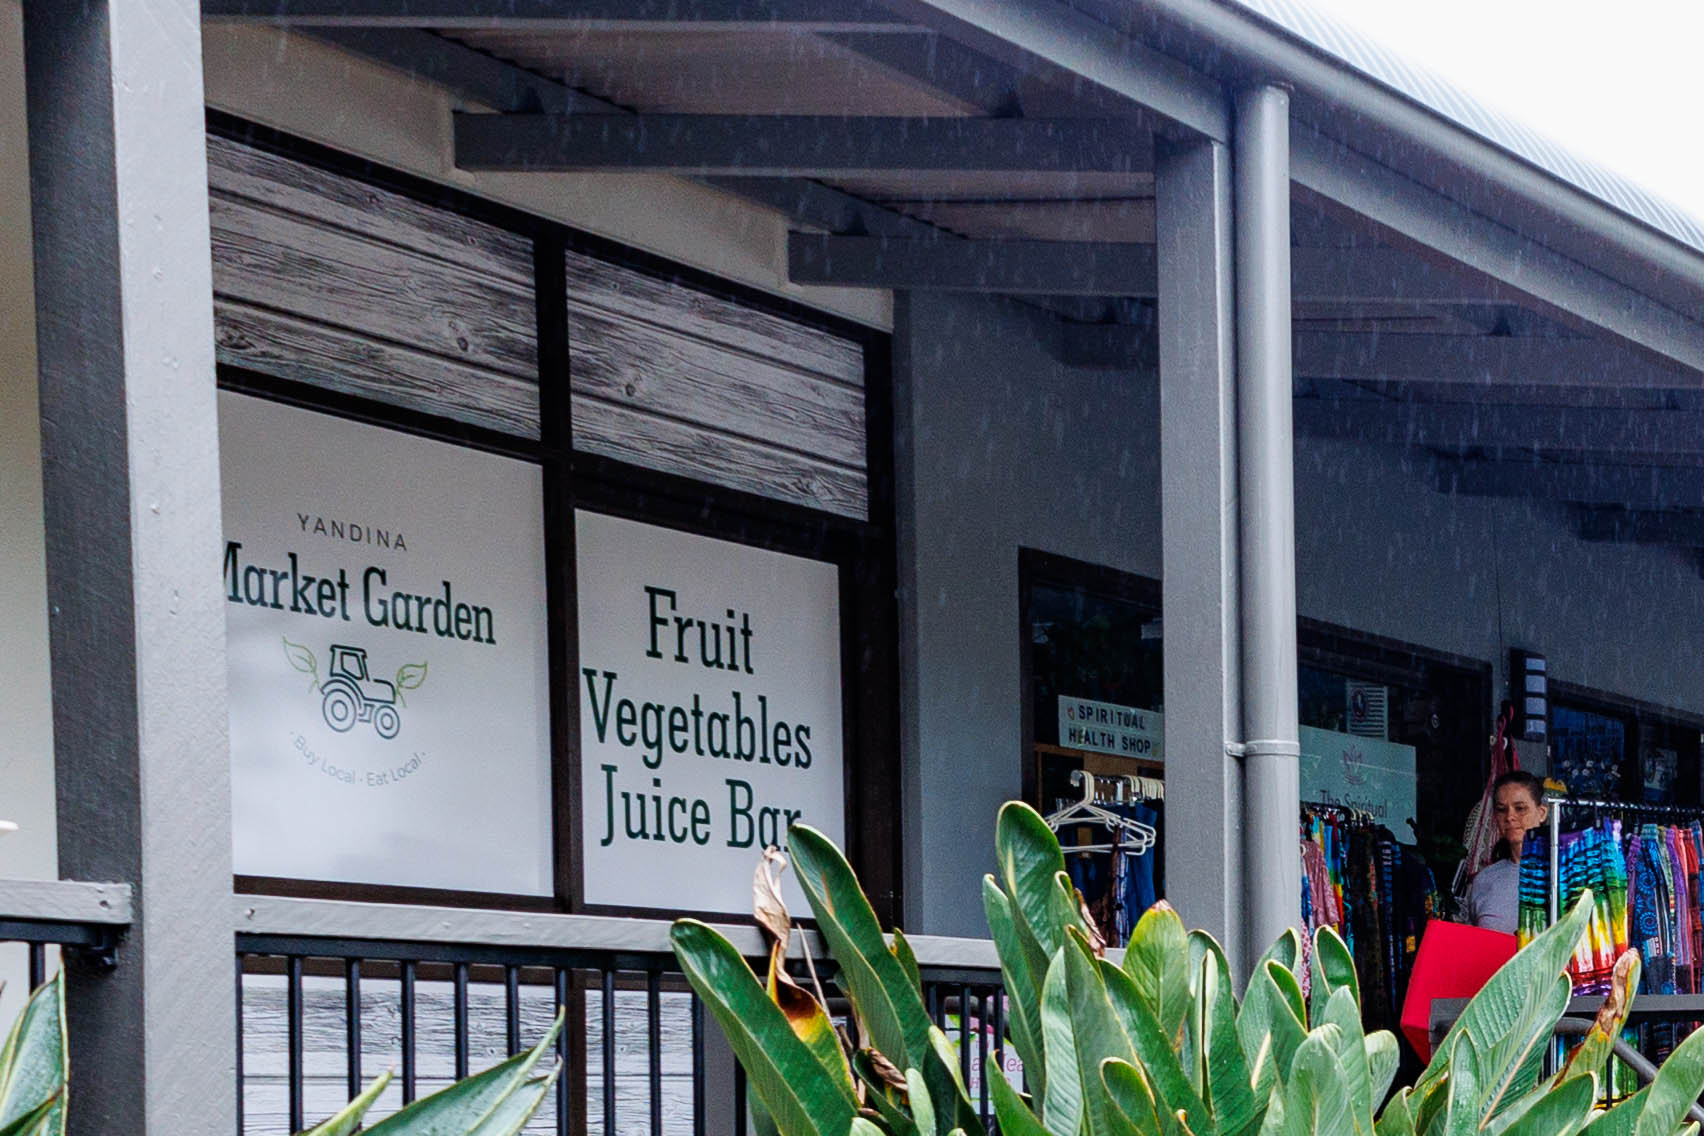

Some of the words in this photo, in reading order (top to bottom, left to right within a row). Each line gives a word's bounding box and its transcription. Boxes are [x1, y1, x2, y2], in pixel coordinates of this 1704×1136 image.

[297, 513, 408, 551] YANDINA
[362, 565, 497, 645] Garden
[644, 585, 754, 675] Fruit
[582, 667, 812, 770] Vegetables
[1068, 727, 1115, 749] HEALTH
[1121, 736, 1151, 754] SHOP
[1078, 704, 1145, 730] SPIRITUAL
[320, 757, 356, 785] Local
[366, 771, 390, 787] Eat
[390, 752, 423, 782] Local
[600, 763, 711, 847] Juice
